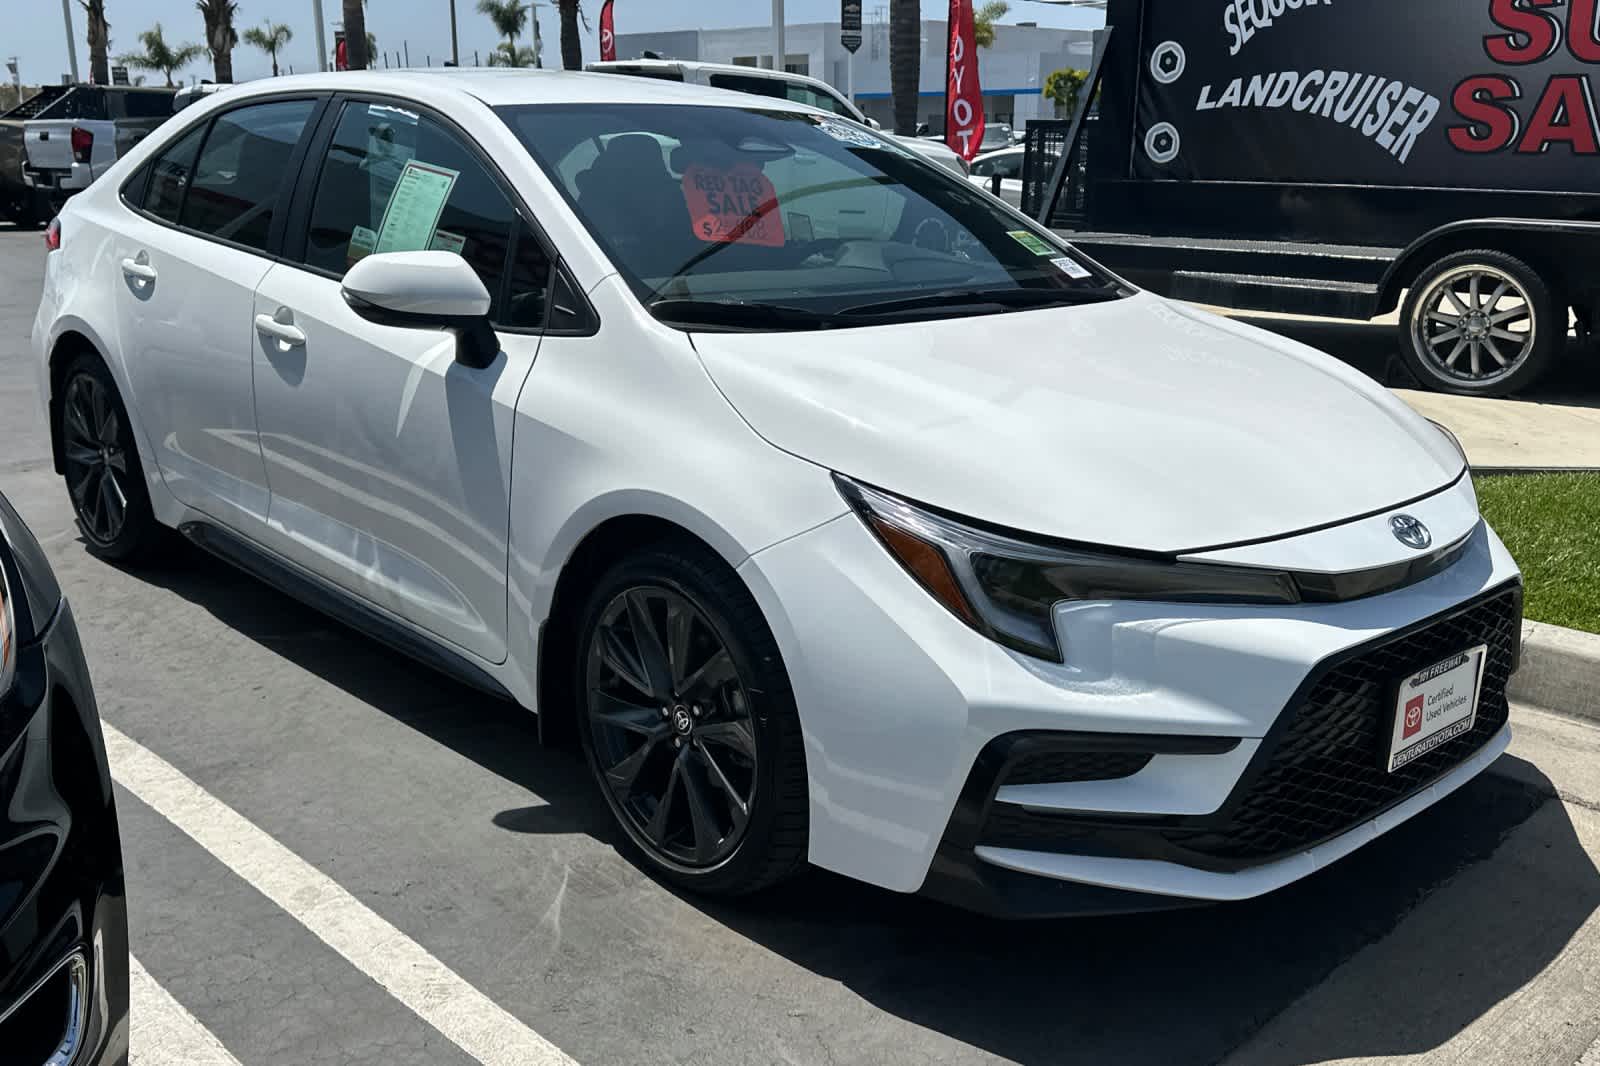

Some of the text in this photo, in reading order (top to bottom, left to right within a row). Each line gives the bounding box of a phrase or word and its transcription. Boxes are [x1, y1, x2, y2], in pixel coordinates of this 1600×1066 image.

[1224, 0, 1332, 56] SEQU
[1196, 69, 1441, 165] LANDCRUISER
[695, 174, 764, 196] RED TAG
[706, 191, 761, 217] SALE
[1430, 655, 1462, 680] FREEWAY
[1427, 683, 1454, 706] Certified
[1426, 696, 1468, 721] Used Vehicles
